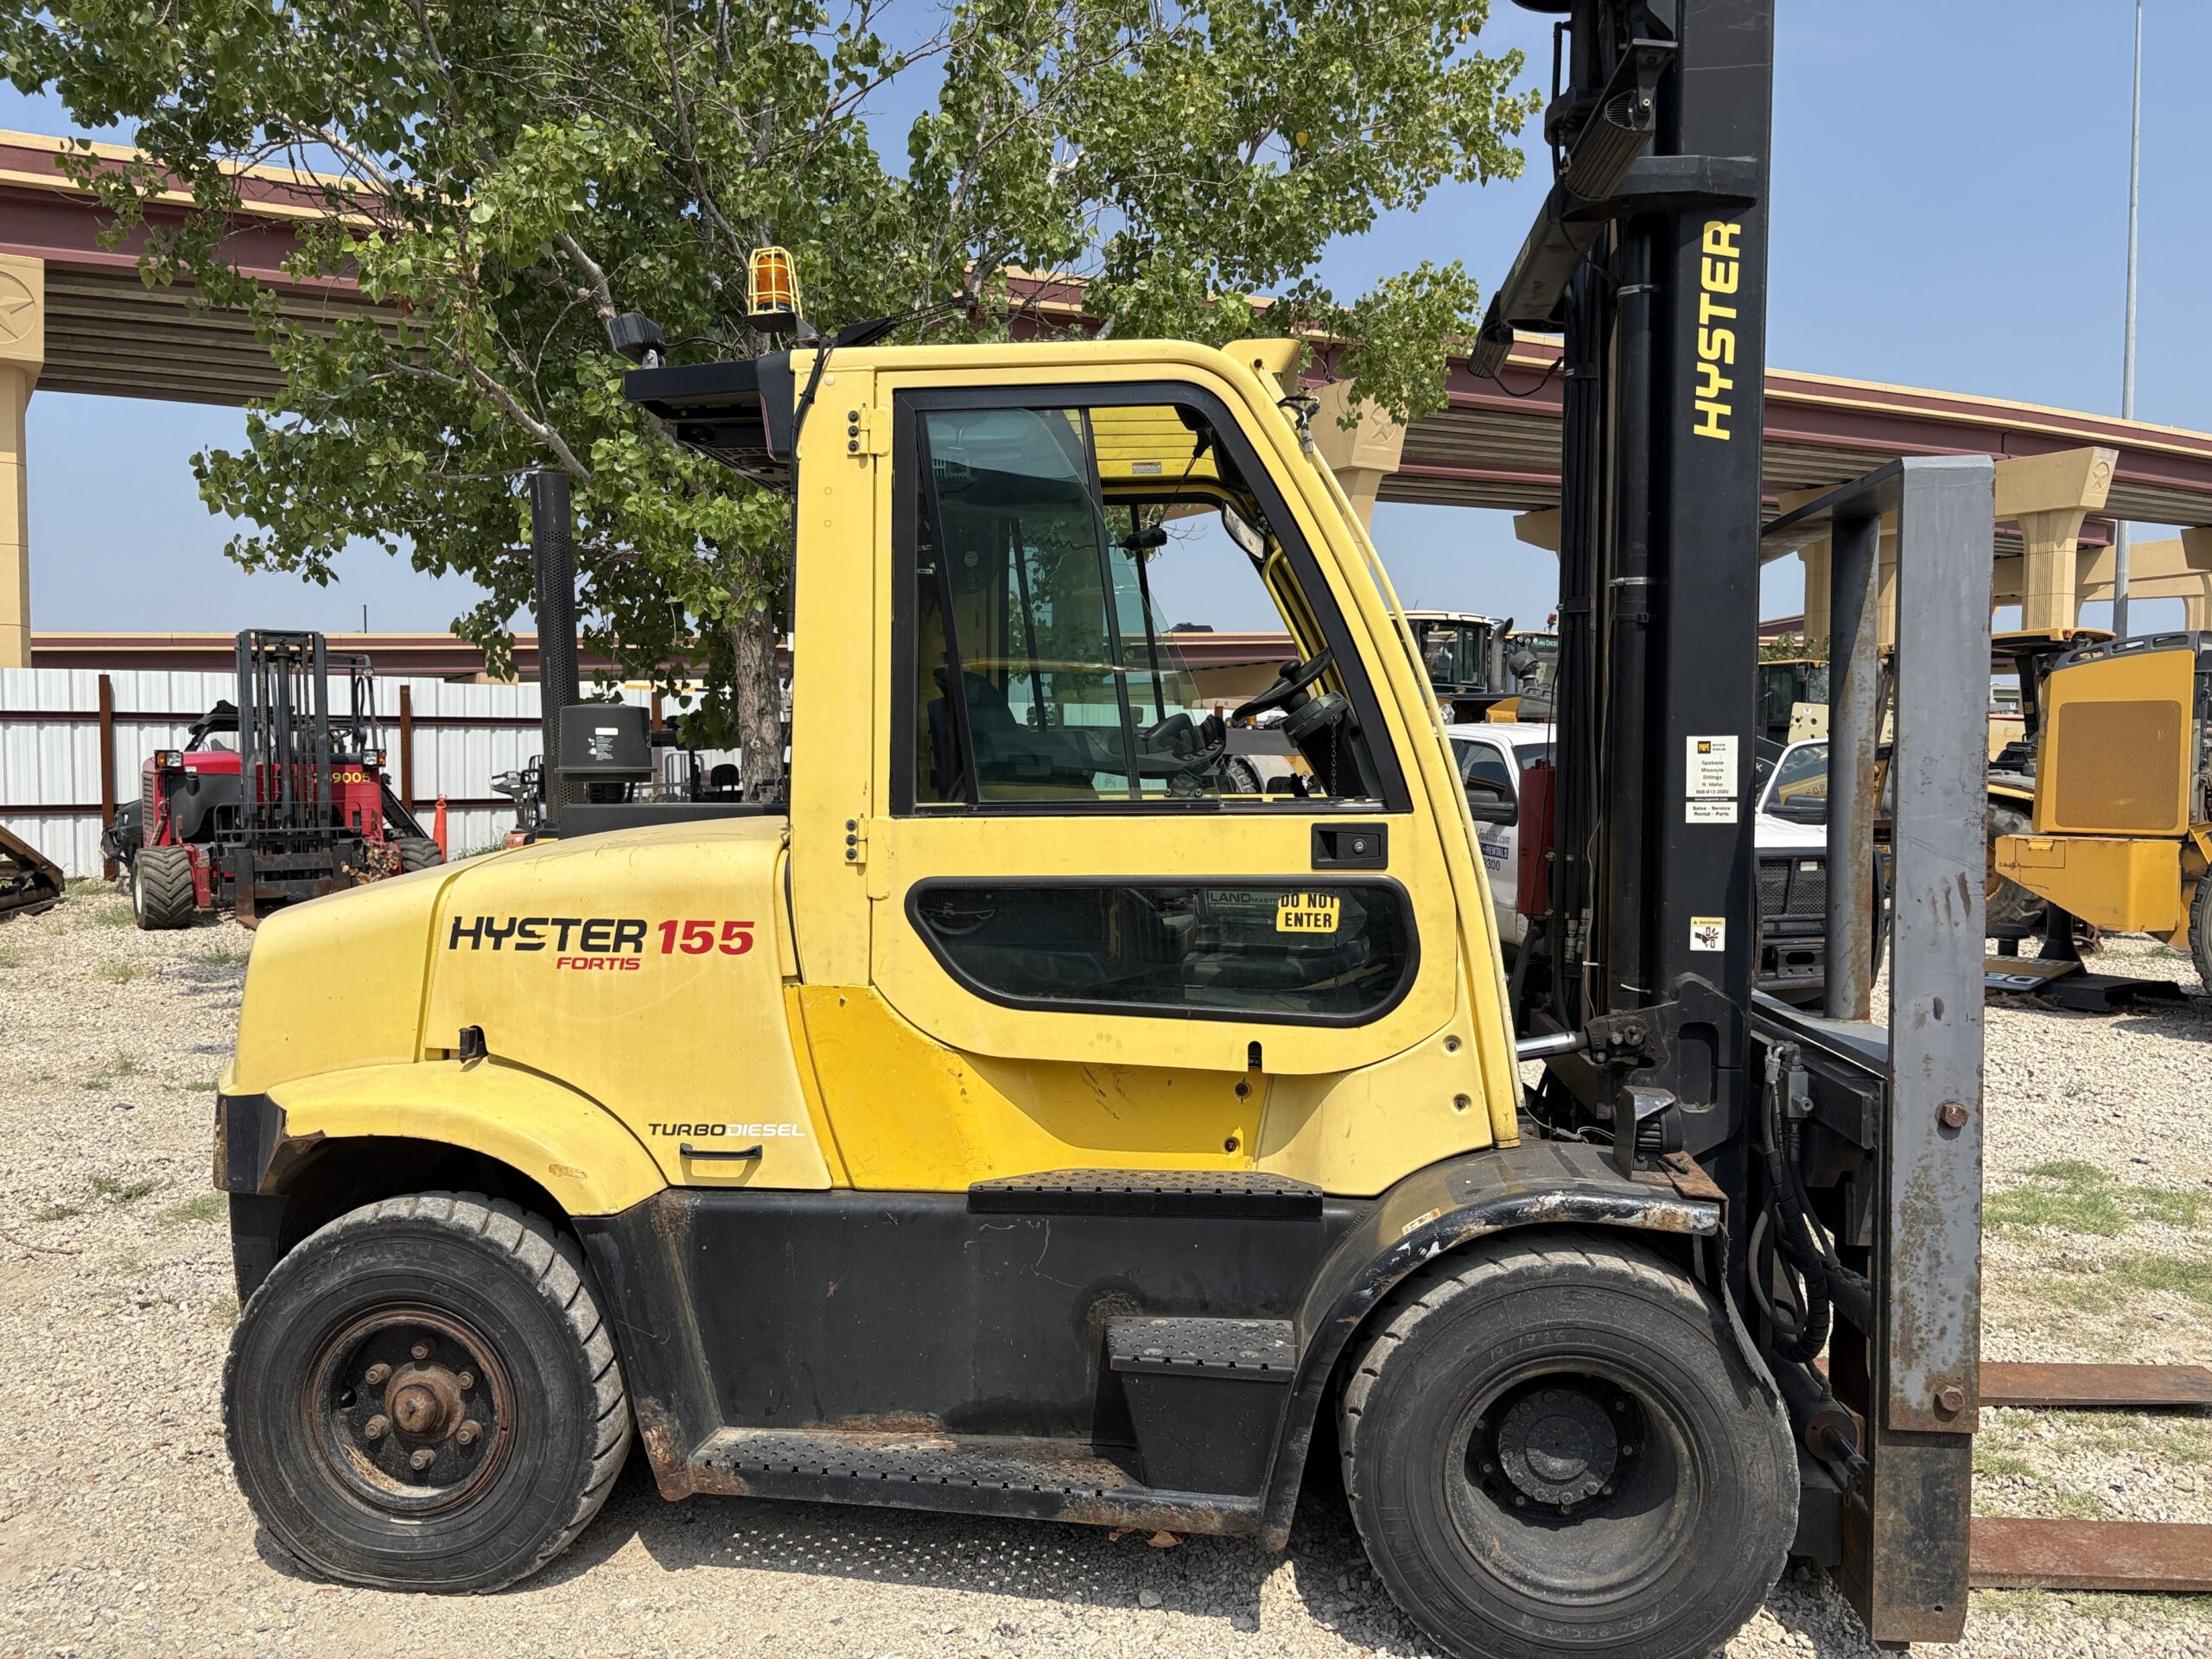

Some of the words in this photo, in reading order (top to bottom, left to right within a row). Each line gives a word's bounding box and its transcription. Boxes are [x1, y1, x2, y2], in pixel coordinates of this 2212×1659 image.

[1693, 219, 1741, 441] HYSTER
[1281, 893, 1300, 907] DO
[1307, 893, 1335, 908] NOT
[1285, 912, 1332, 928] ENTER
[448, 916, 647, 953] HYSTER
[658, 920, 754, 955] 155
[556, 957, 641, 970] FORTIS
